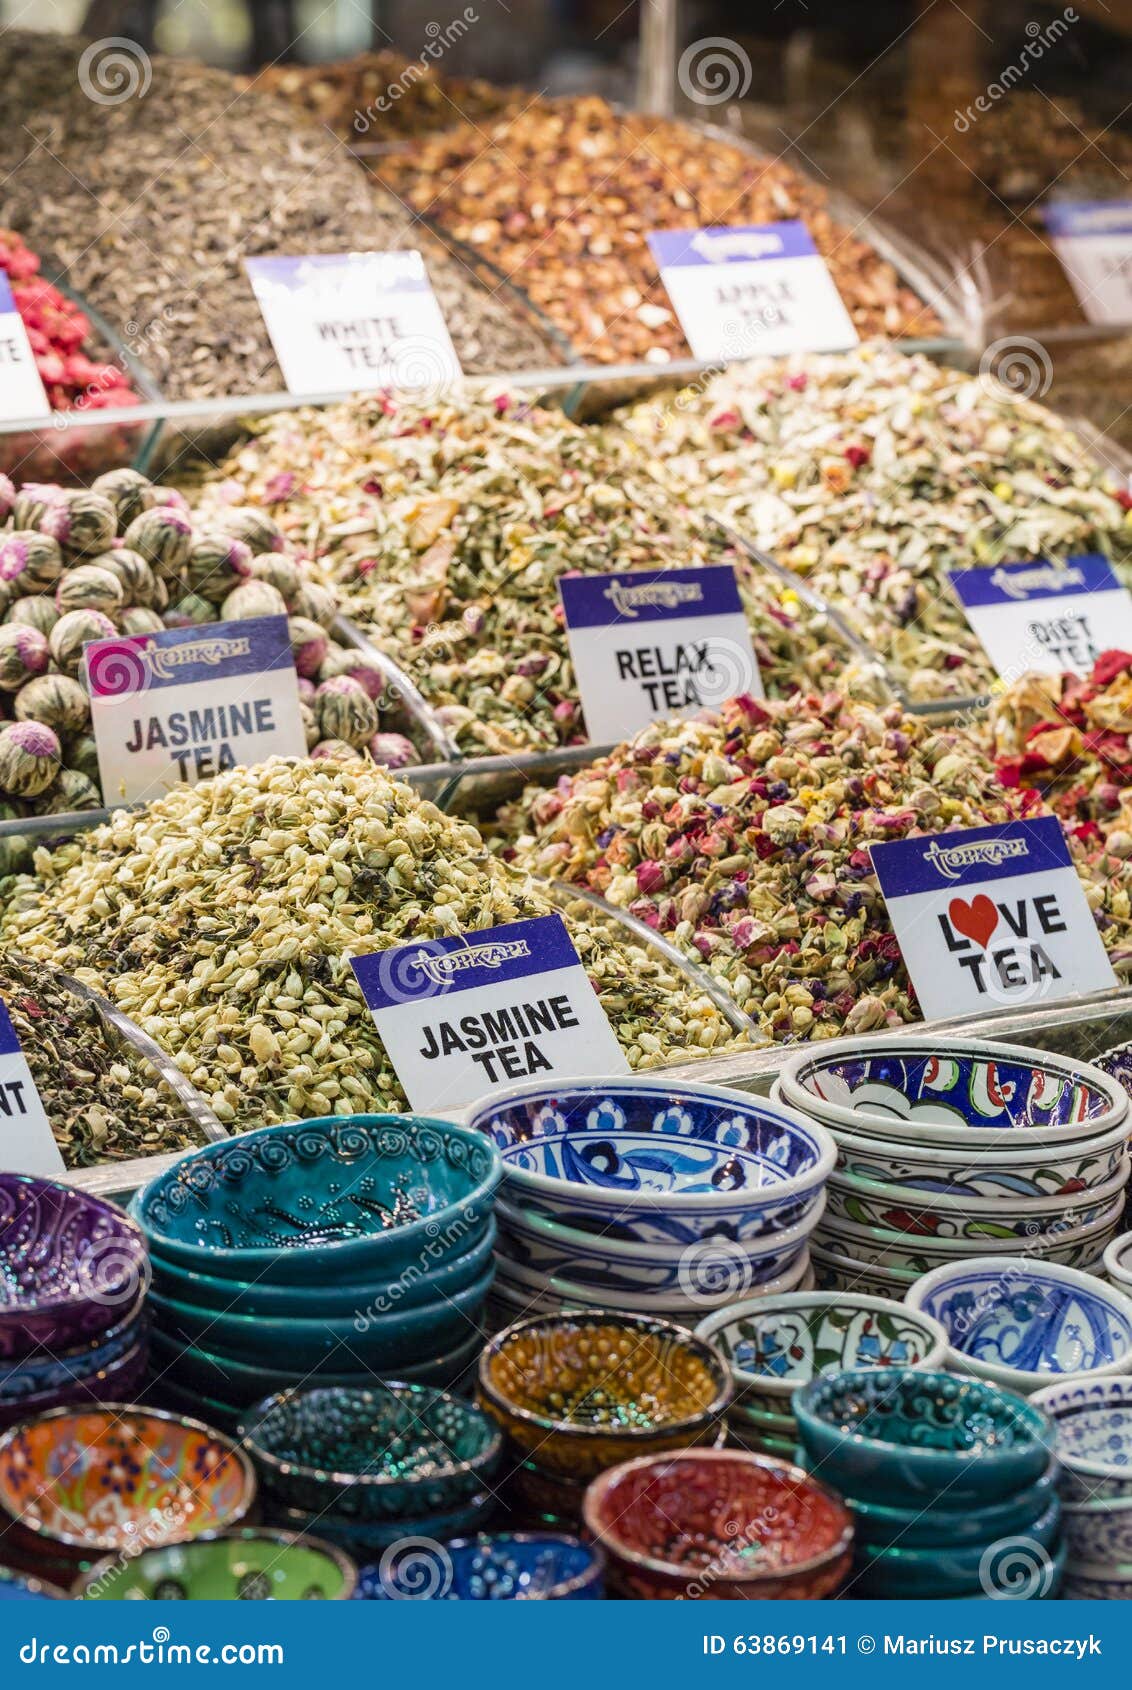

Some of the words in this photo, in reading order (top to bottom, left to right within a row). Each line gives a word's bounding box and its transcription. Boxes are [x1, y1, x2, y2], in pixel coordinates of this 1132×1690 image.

[315, 317, 402, 341] WHITE
[341, 346, 397, 369] TEA
[616, 642, 714, 680] RELAX
[641, 680, 702, 711] TEA
[126, 698, 276, 753] JASMINE
[171, 743, 237, 783] TEA
[411, 940, 531, 985] TOPKAPI
[958, 944, 1063, 994] TEA
[419, 995, 580, 1060] JASMINE
[472, 1042, 553, 1083] TEA
